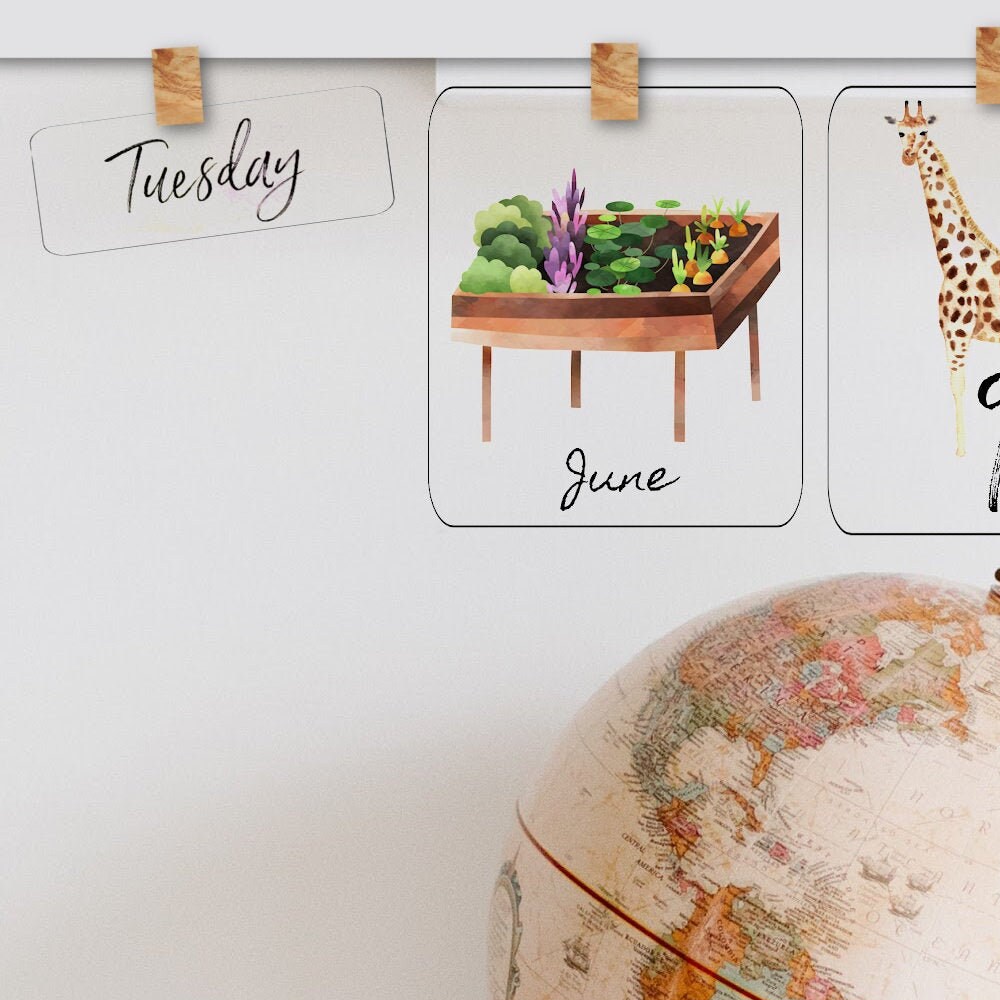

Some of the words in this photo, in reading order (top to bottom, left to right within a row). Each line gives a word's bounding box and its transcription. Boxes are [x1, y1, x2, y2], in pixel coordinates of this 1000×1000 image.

[103, 117, 304, 223] Tuesday
[560, 447, 681, 512] June
[635, 858, 664, 881] AMERICA
